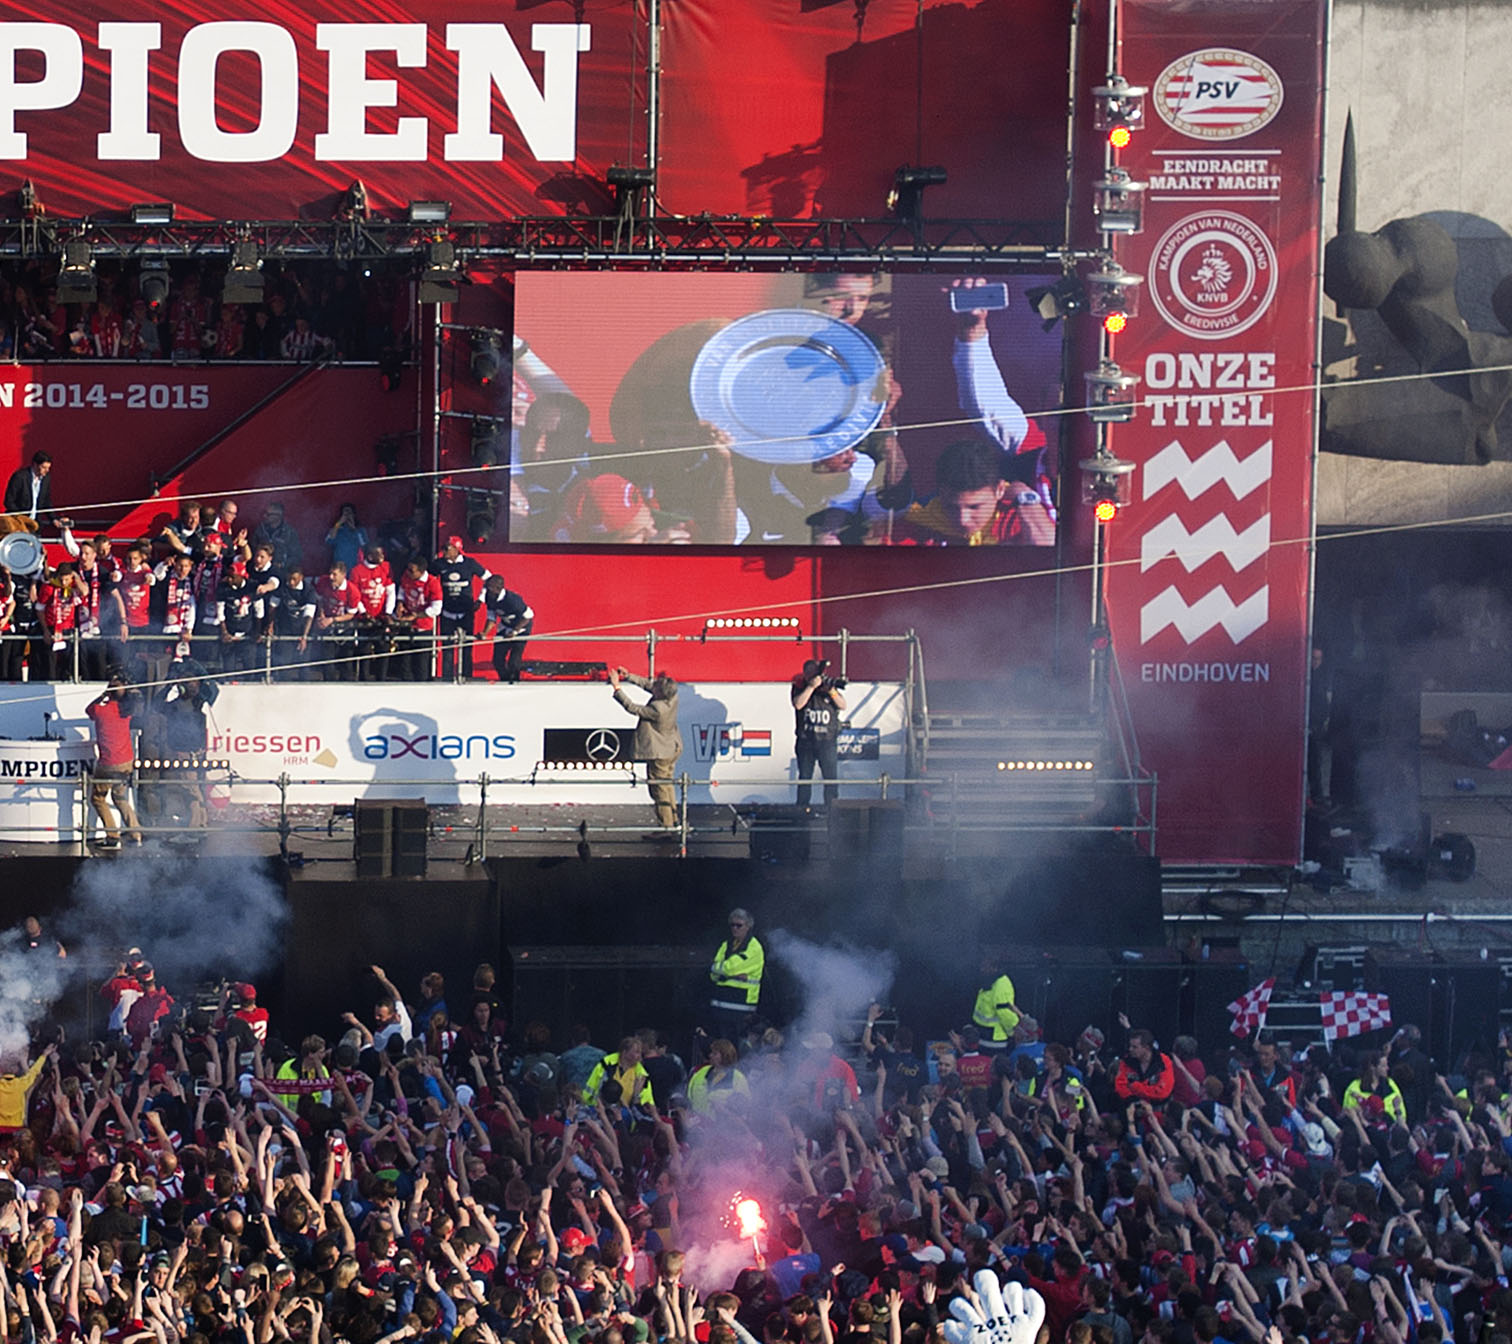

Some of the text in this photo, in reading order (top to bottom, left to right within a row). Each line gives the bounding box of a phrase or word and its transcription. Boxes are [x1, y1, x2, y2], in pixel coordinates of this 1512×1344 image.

[1195, 81, 1241, 100] PSV
[1163, 159, 1269, 174] EENDRACHT
[1149, 176, 1281, 190] MAAKT MACHT
[1158, 217, 1268, 271] KAMPIOEN VAN NEDERLAND
[1196, 293, 1228, 303] KNVB
[1183, 312, 1240, 329] EREDIVISIE
[1145, 353, 1276, 389] ONZE
[23, 383, 209, 409] 2014-2015
[1144, 394, 1274, 427] TITEL
[1141, 662, 1270, 683] EINDHOVEN
[205, 727, 321, 753] riessen
[363, 733, 516, 761] axians
[692, 722, 751, 763] VDL
[283, 756, 309, 766] HRM
